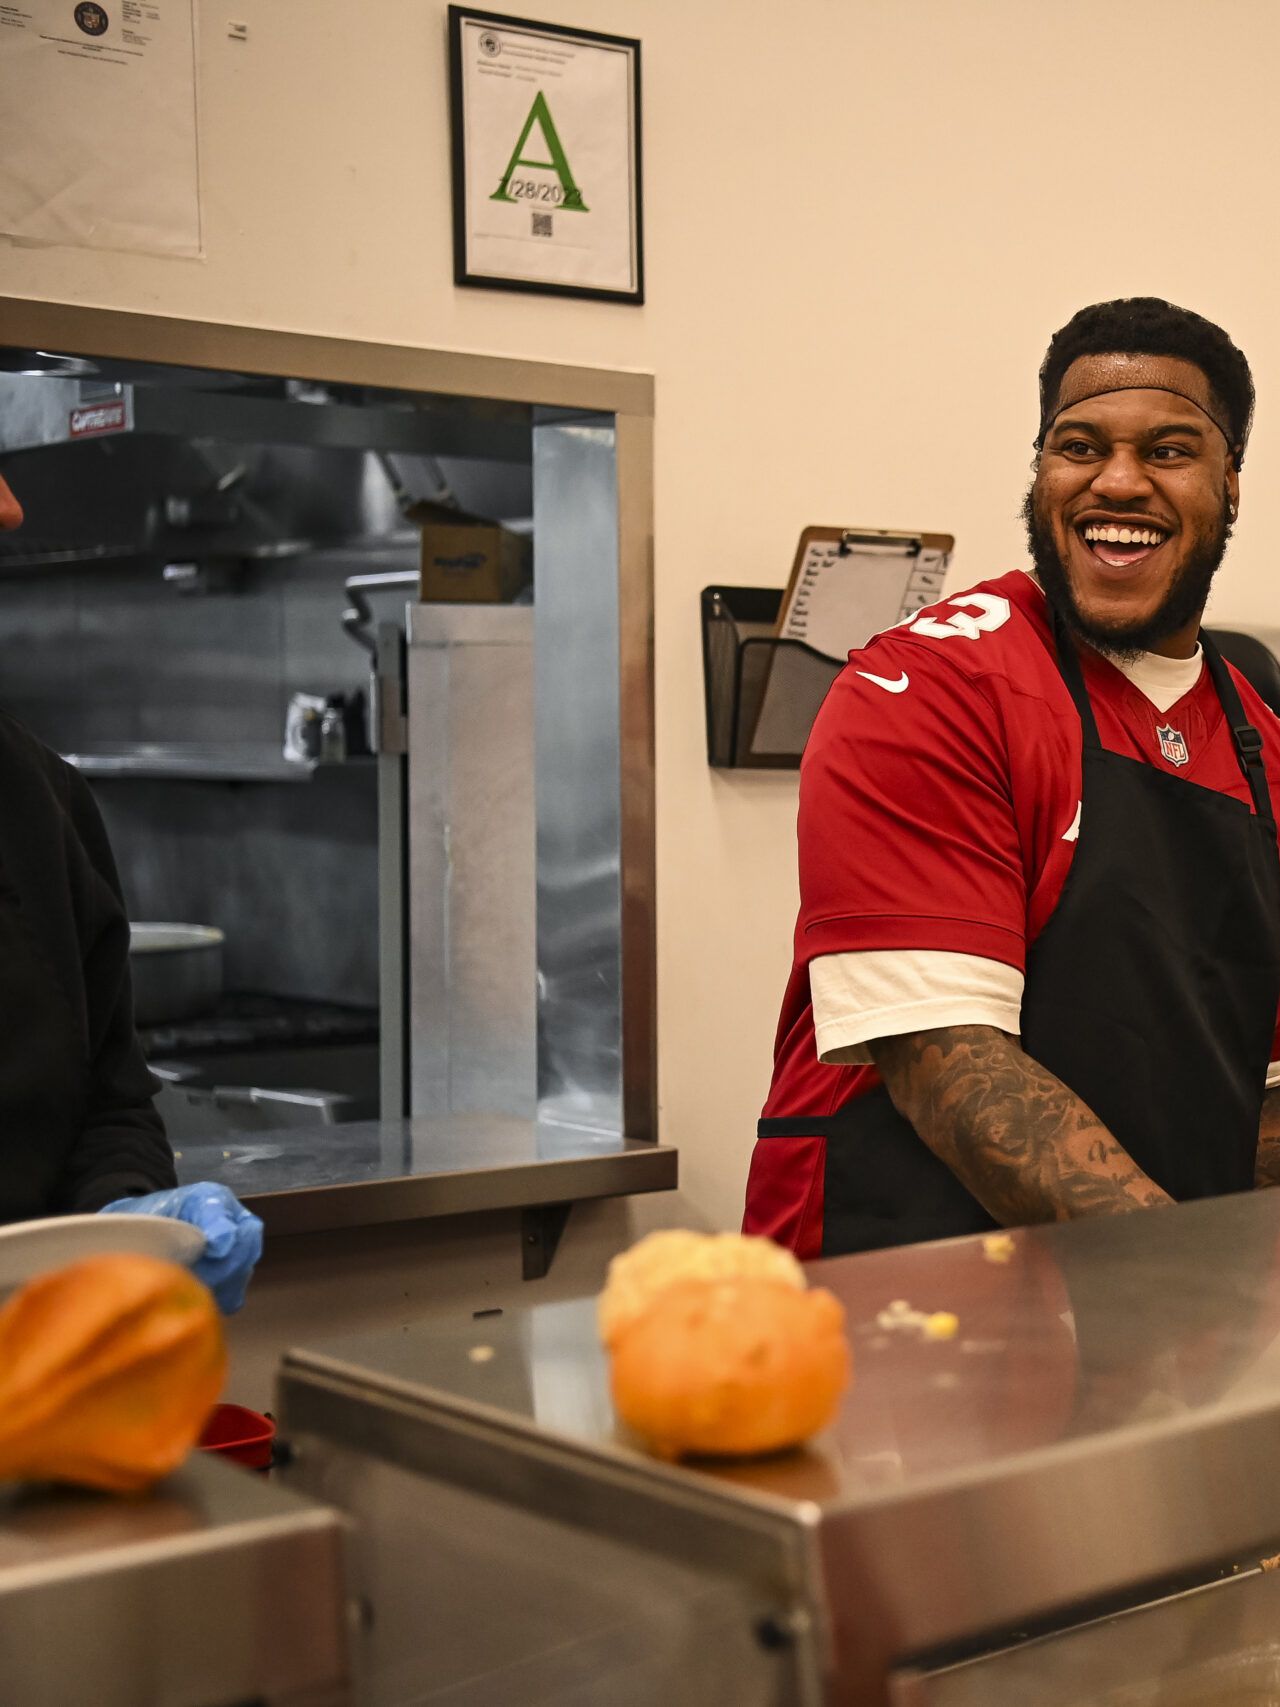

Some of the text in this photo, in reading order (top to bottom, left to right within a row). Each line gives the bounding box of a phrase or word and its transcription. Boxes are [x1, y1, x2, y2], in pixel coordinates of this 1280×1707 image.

[489, 90, 590, 211] A
[899, 593, 1012, 641] 3
[1165, 741, 1185, 759] NFL
